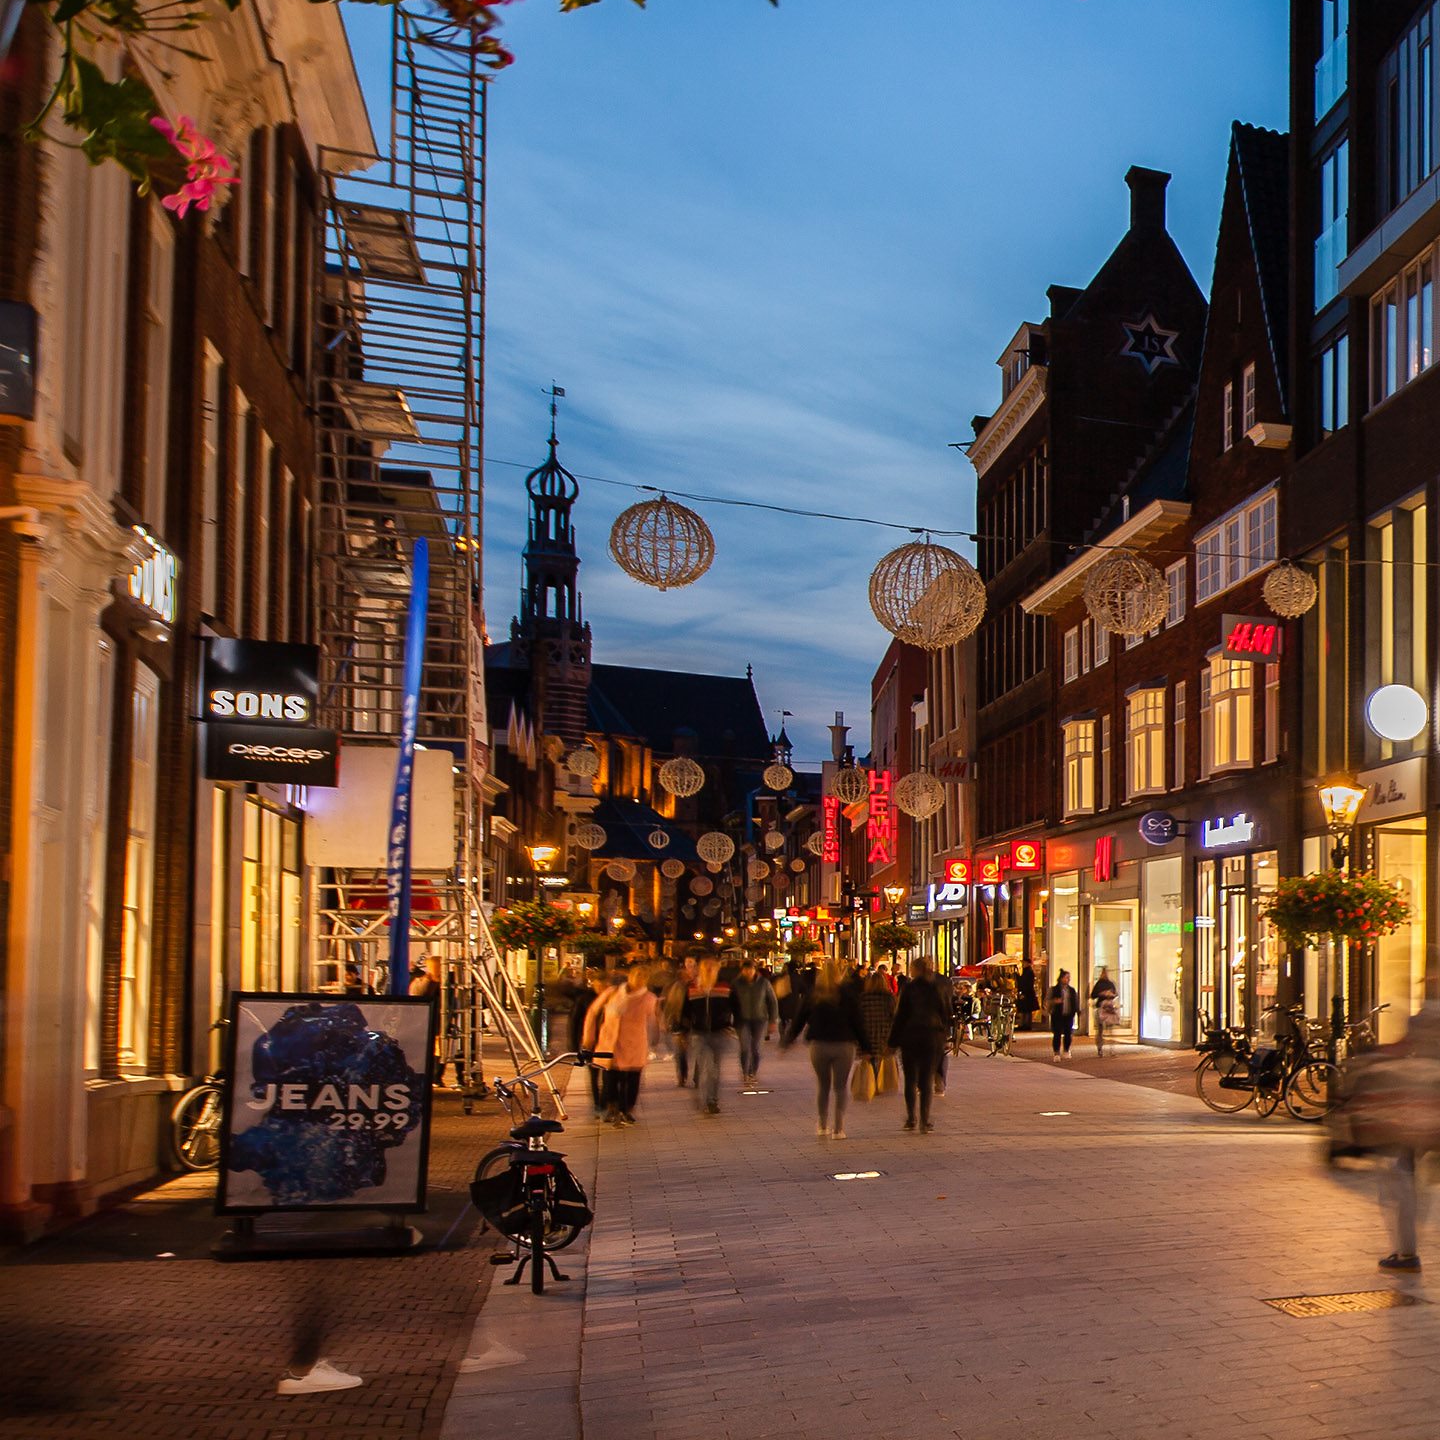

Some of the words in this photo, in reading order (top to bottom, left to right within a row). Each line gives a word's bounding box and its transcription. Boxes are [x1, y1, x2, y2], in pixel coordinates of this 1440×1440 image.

[209, 689, 310, 720] SONS
[229, 743, 325, 760] pieces
[867, 769, 892, 863] HEMA
[935, 883, 966, 901] JD
[246, 1083, 411, 1111] JEANS
